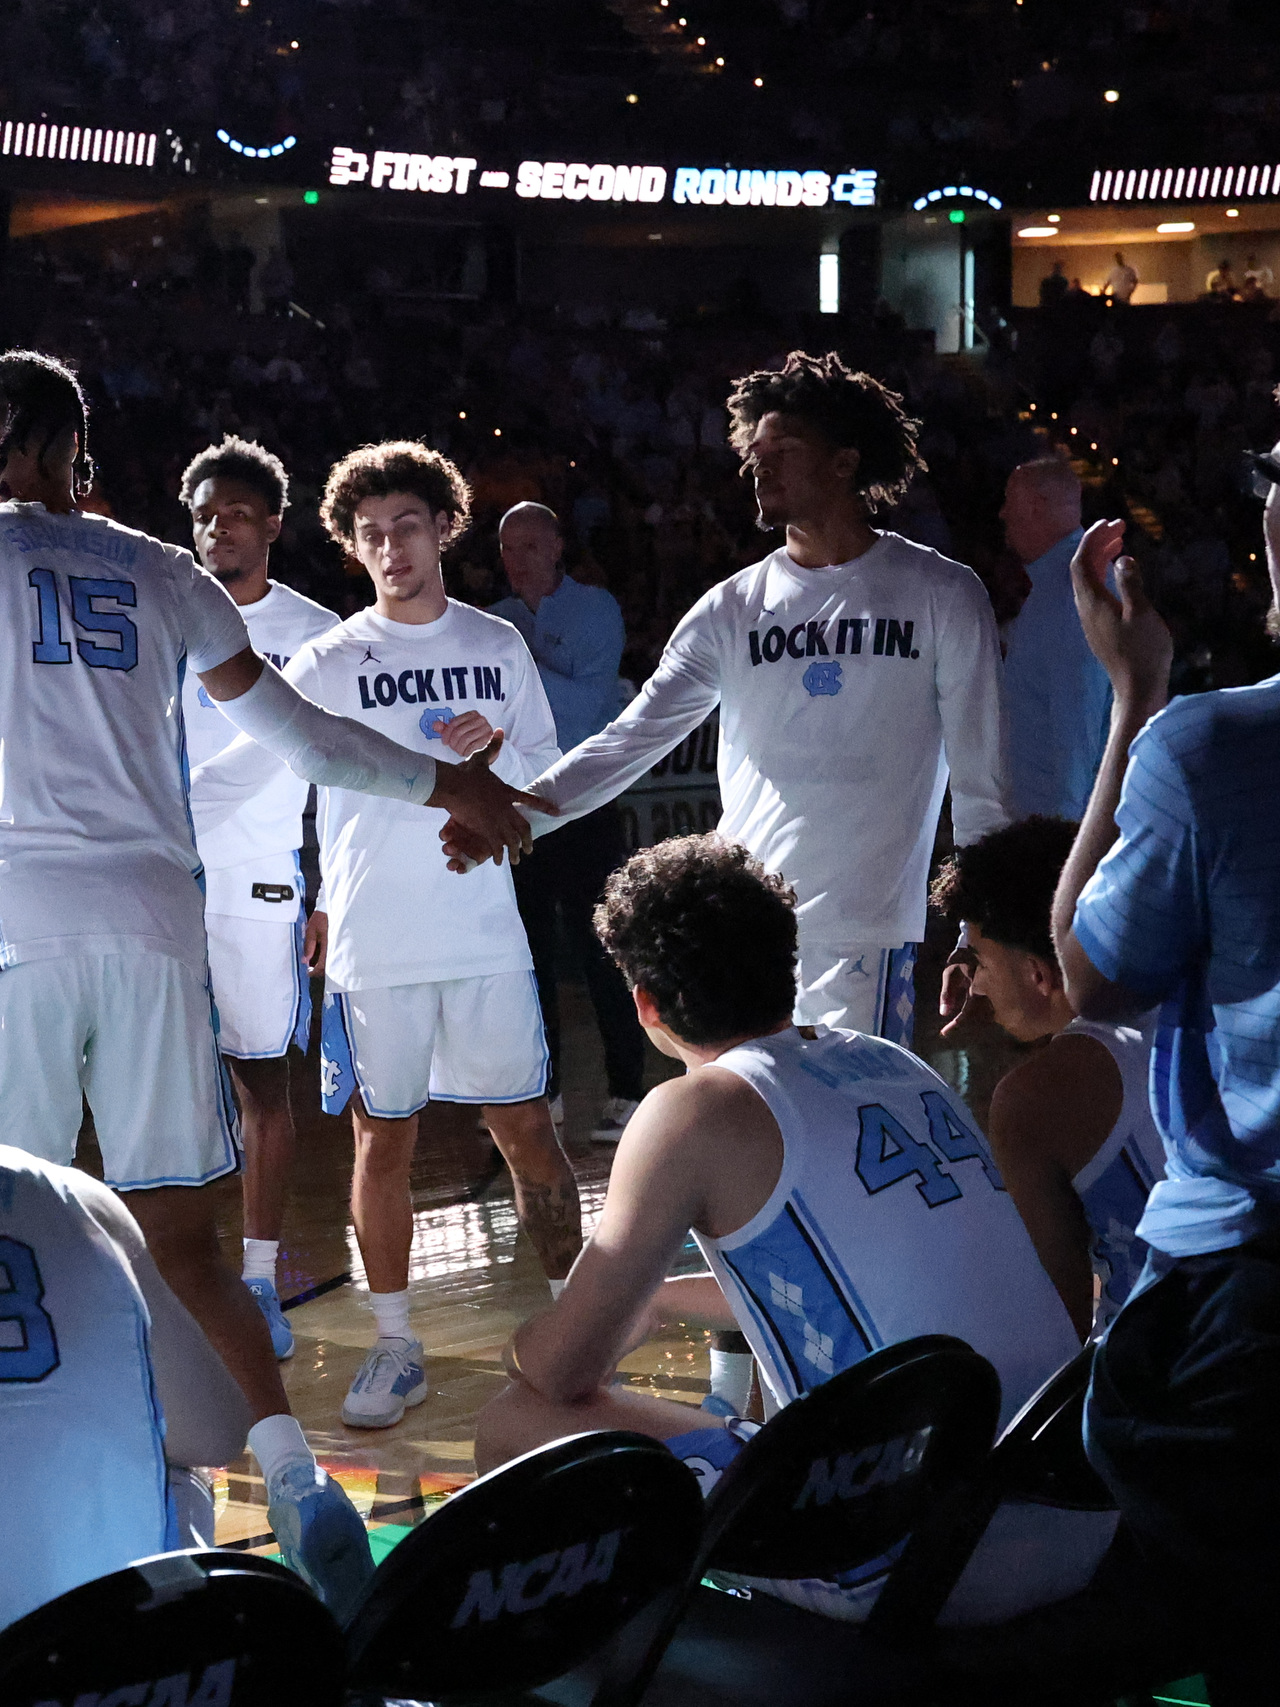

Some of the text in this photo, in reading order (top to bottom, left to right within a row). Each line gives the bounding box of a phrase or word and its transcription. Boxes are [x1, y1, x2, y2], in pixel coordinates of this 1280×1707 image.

[371, 151, 477, 194] FIRST
[515, 161, 667, 202] SECOND
[673, 167, 831, 206] ROUNDS
[28, 567, 138, 672] 15
[749, 619, 920, 666] LOCK IT IN.
[358, 666, 506, 709] LOCK IT IN.
[855, 1091, 1009, 1209] 44
[792, 1425, 933, 1511] NCAA
[449, 1528, 622, 1630] NCAA
